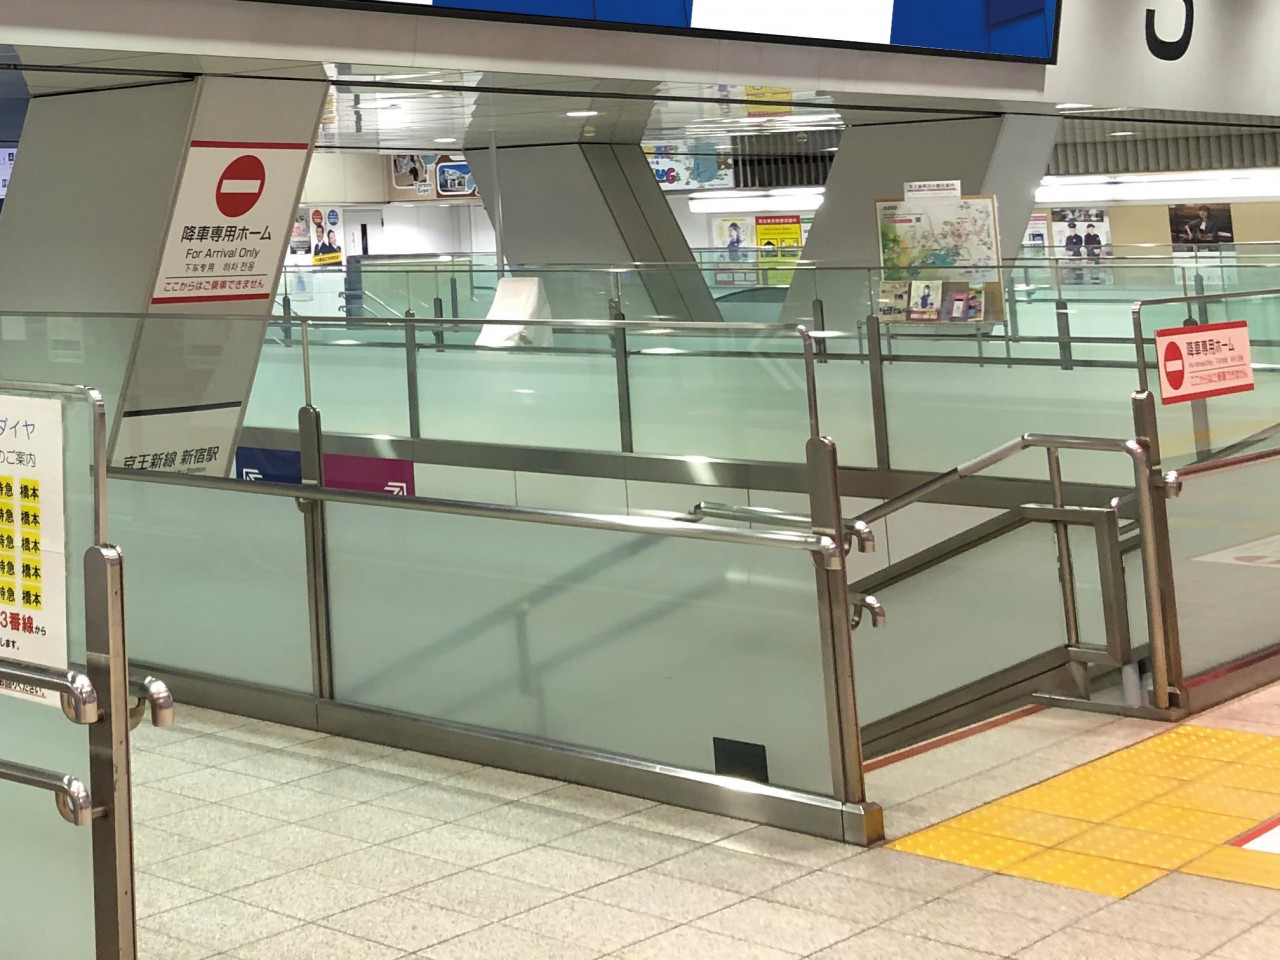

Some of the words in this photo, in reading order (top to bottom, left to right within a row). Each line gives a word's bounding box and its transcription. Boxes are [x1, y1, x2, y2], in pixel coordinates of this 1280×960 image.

[181, 225, 272, 243] 降車専用ホーム
[186, 249, 202, 259] For
[204, 248, 237, 258] Arrival
[239, 247, 261, 259] Only
[163, 279, 265, 292] ここからはご乗車できません
[180, 446, 220, 465] 新宿駅
[20, 484, 40, 500] 橋本
[20, 511, 40, 527] 橋本
[21, 536, 41, 553] 橋本
[21, 562, 42, 579] 橋本
[22, 589, 42, 606] 橋本
